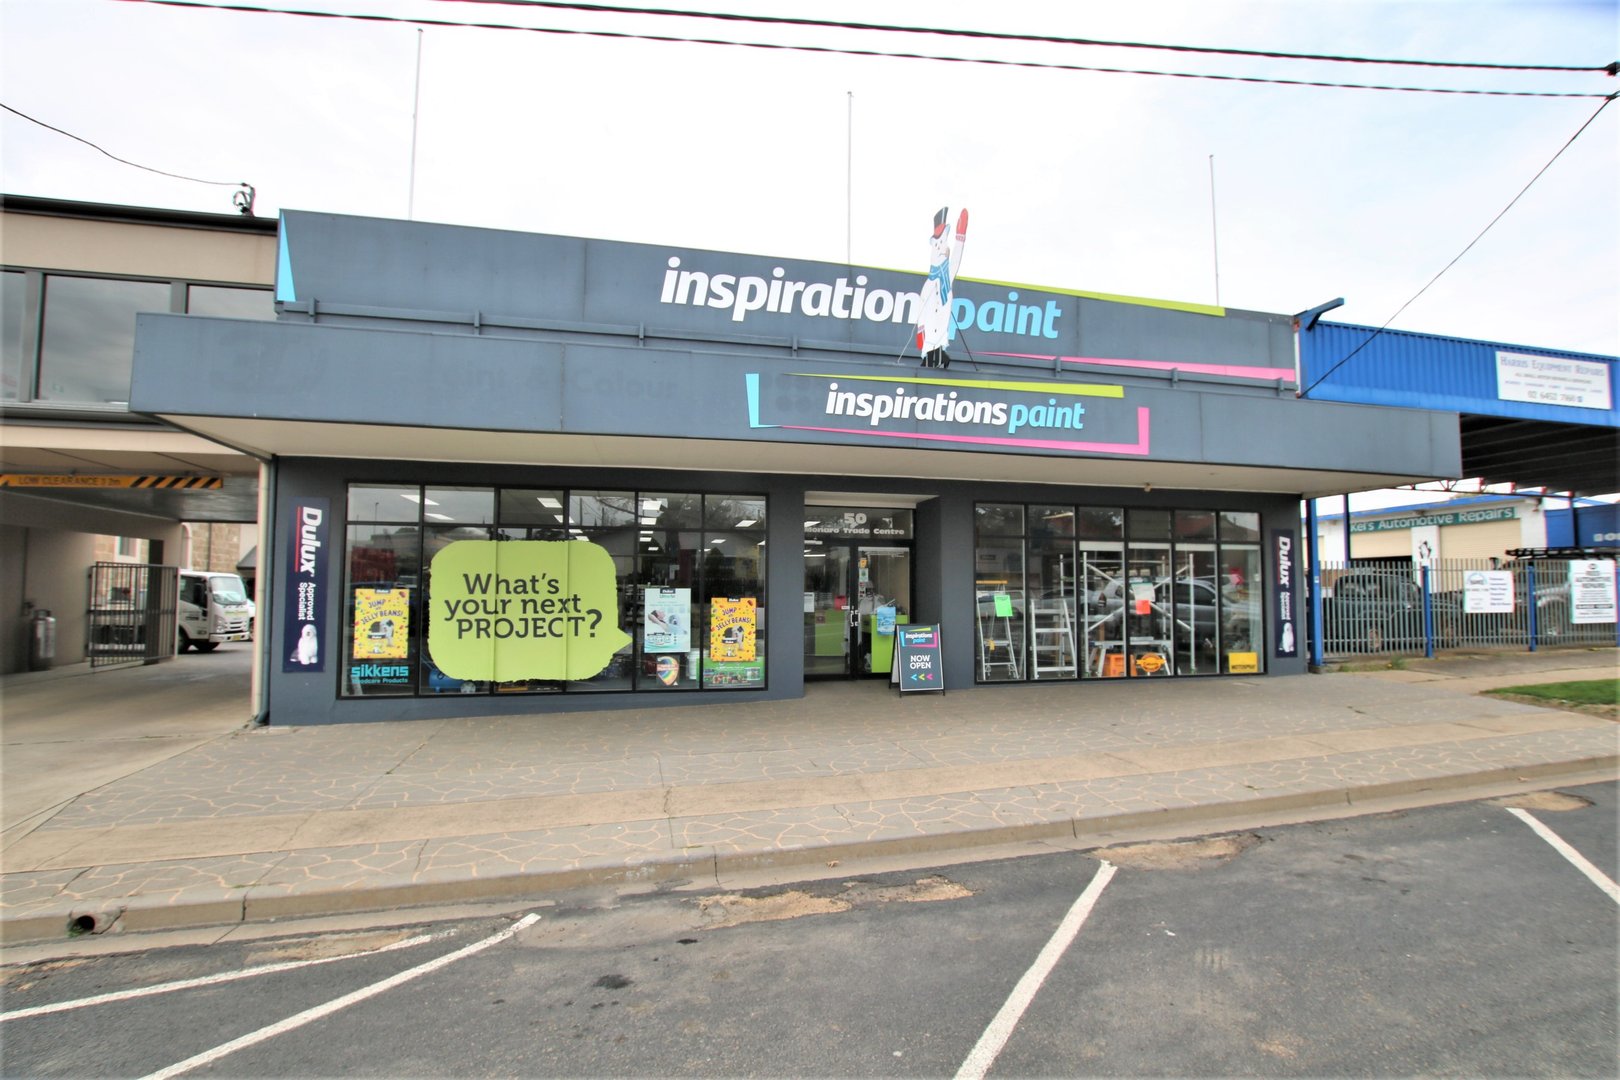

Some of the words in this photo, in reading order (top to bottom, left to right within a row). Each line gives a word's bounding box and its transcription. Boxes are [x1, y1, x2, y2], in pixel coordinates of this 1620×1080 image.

[660, 256, 922, 324] inspiration
[948, 291, 1062, 340] paint
[825, 383, 1008, 426] inspirations
[1008, 398, 1085, 434] paint
[43, 477, 98, 486] CLEARANCE
[844, 513, 867, 525] 50
[1378, 513, 1454, 530] Automotive
[1459, 506, 1513, 523] Repairs
[300, 506, 322, 574] Dulux
[1279, 536, 1292, 585] Dulux
[463, 572, 560, 595] What's
[298, 582, 308, 621] Specialist
[307, 582, 317, 621] Approved
[368, 599, 386, 609] JUMP
[444, 598, 512, 621] your
[521, 594, 581, 614] next
[722, 607, 737, 616] JUMP
[361, 612, 378, 625] JELLY
[456, 608, 603, 640] PROJECT?
[716, 619, 731, 631] JELLY
[351, 664, 409, 677] sikkens
